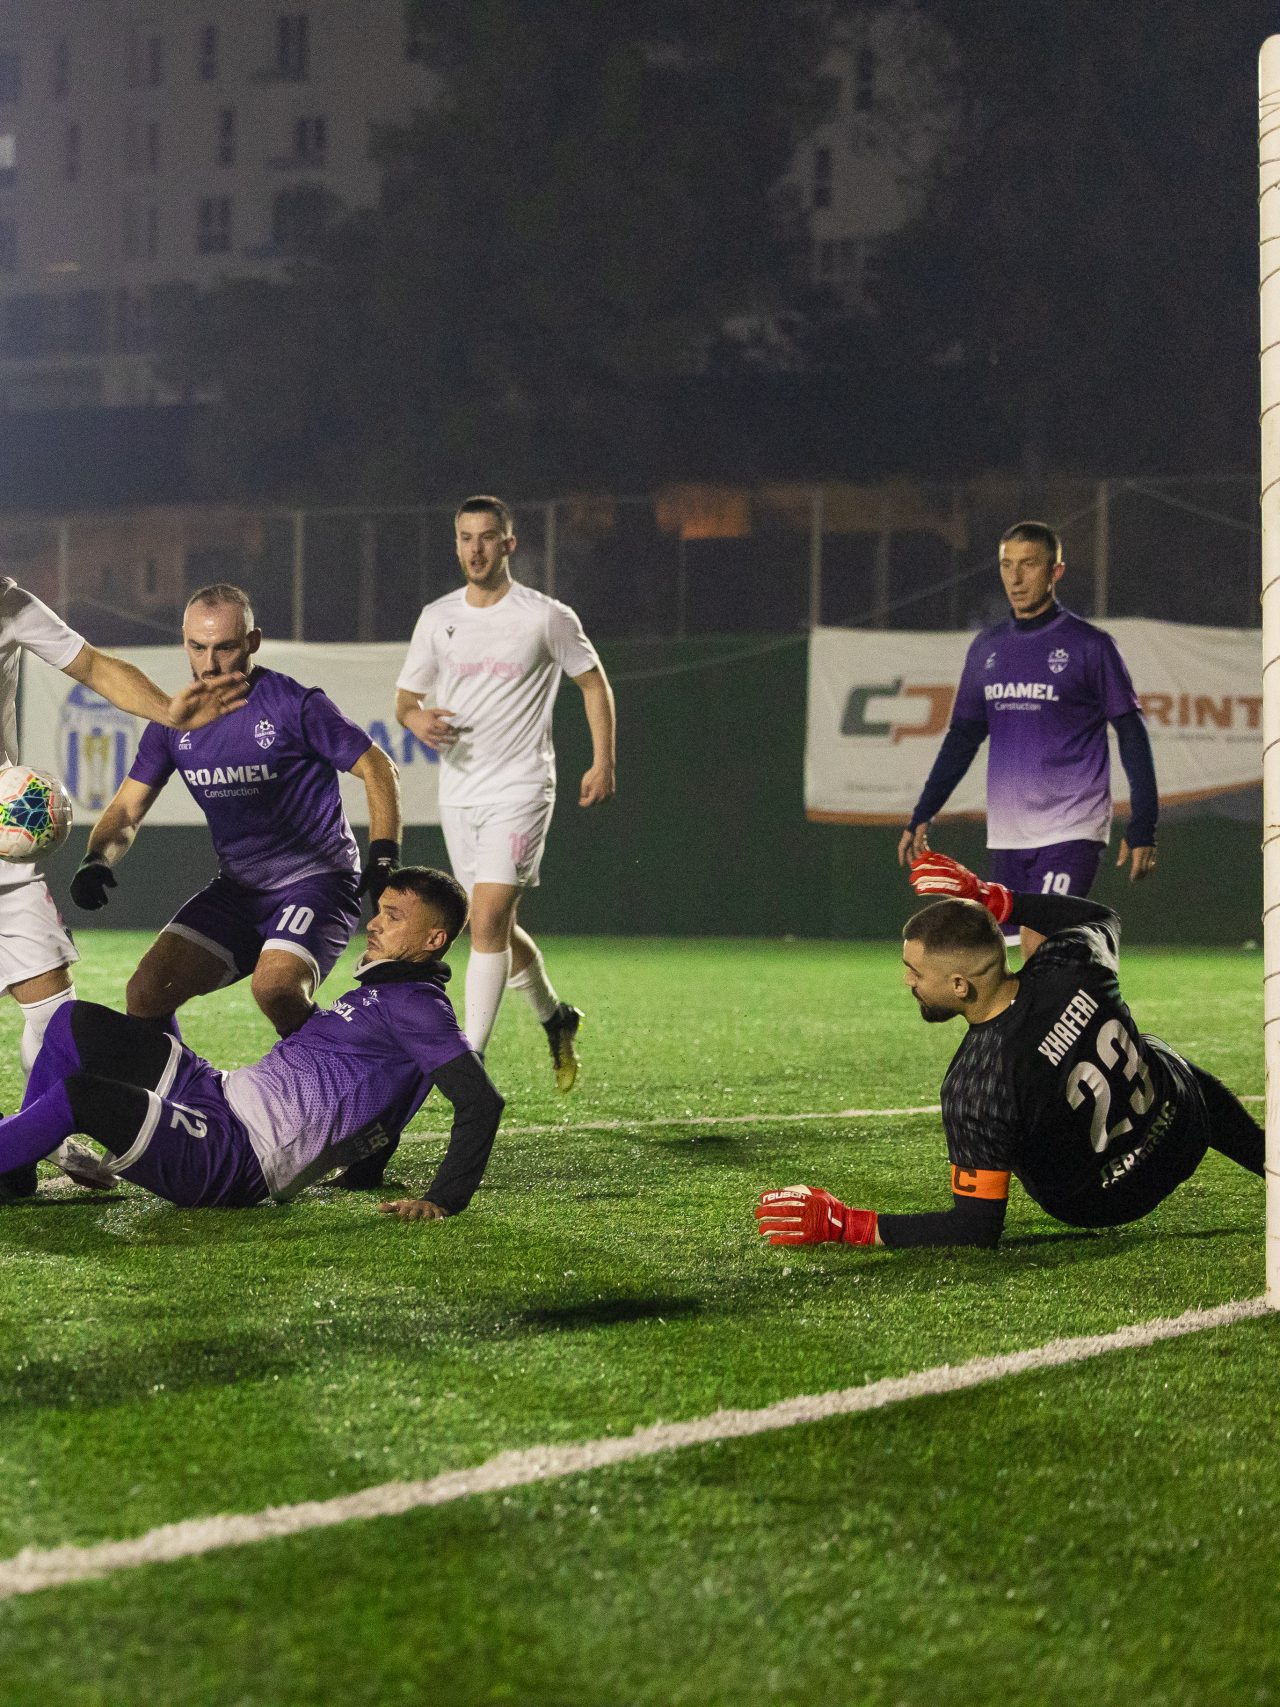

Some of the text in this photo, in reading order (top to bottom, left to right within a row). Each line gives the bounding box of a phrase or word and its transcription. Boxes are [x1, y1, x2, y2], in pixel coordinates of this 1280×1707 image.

[984, 682, 1060, 702] ROAMEL
[1139, 693, 1263, 728] RINT
[183, 764, 278, 786] ROAMEL
[204, 787, 260, 798] Construction
[275, 904, 315, 935] 10
[1038, 989, 1099, 1067] XHAFERI
[1066, 1019, 1155, 1154] 23
[954, 1167, 977, 1193] C
